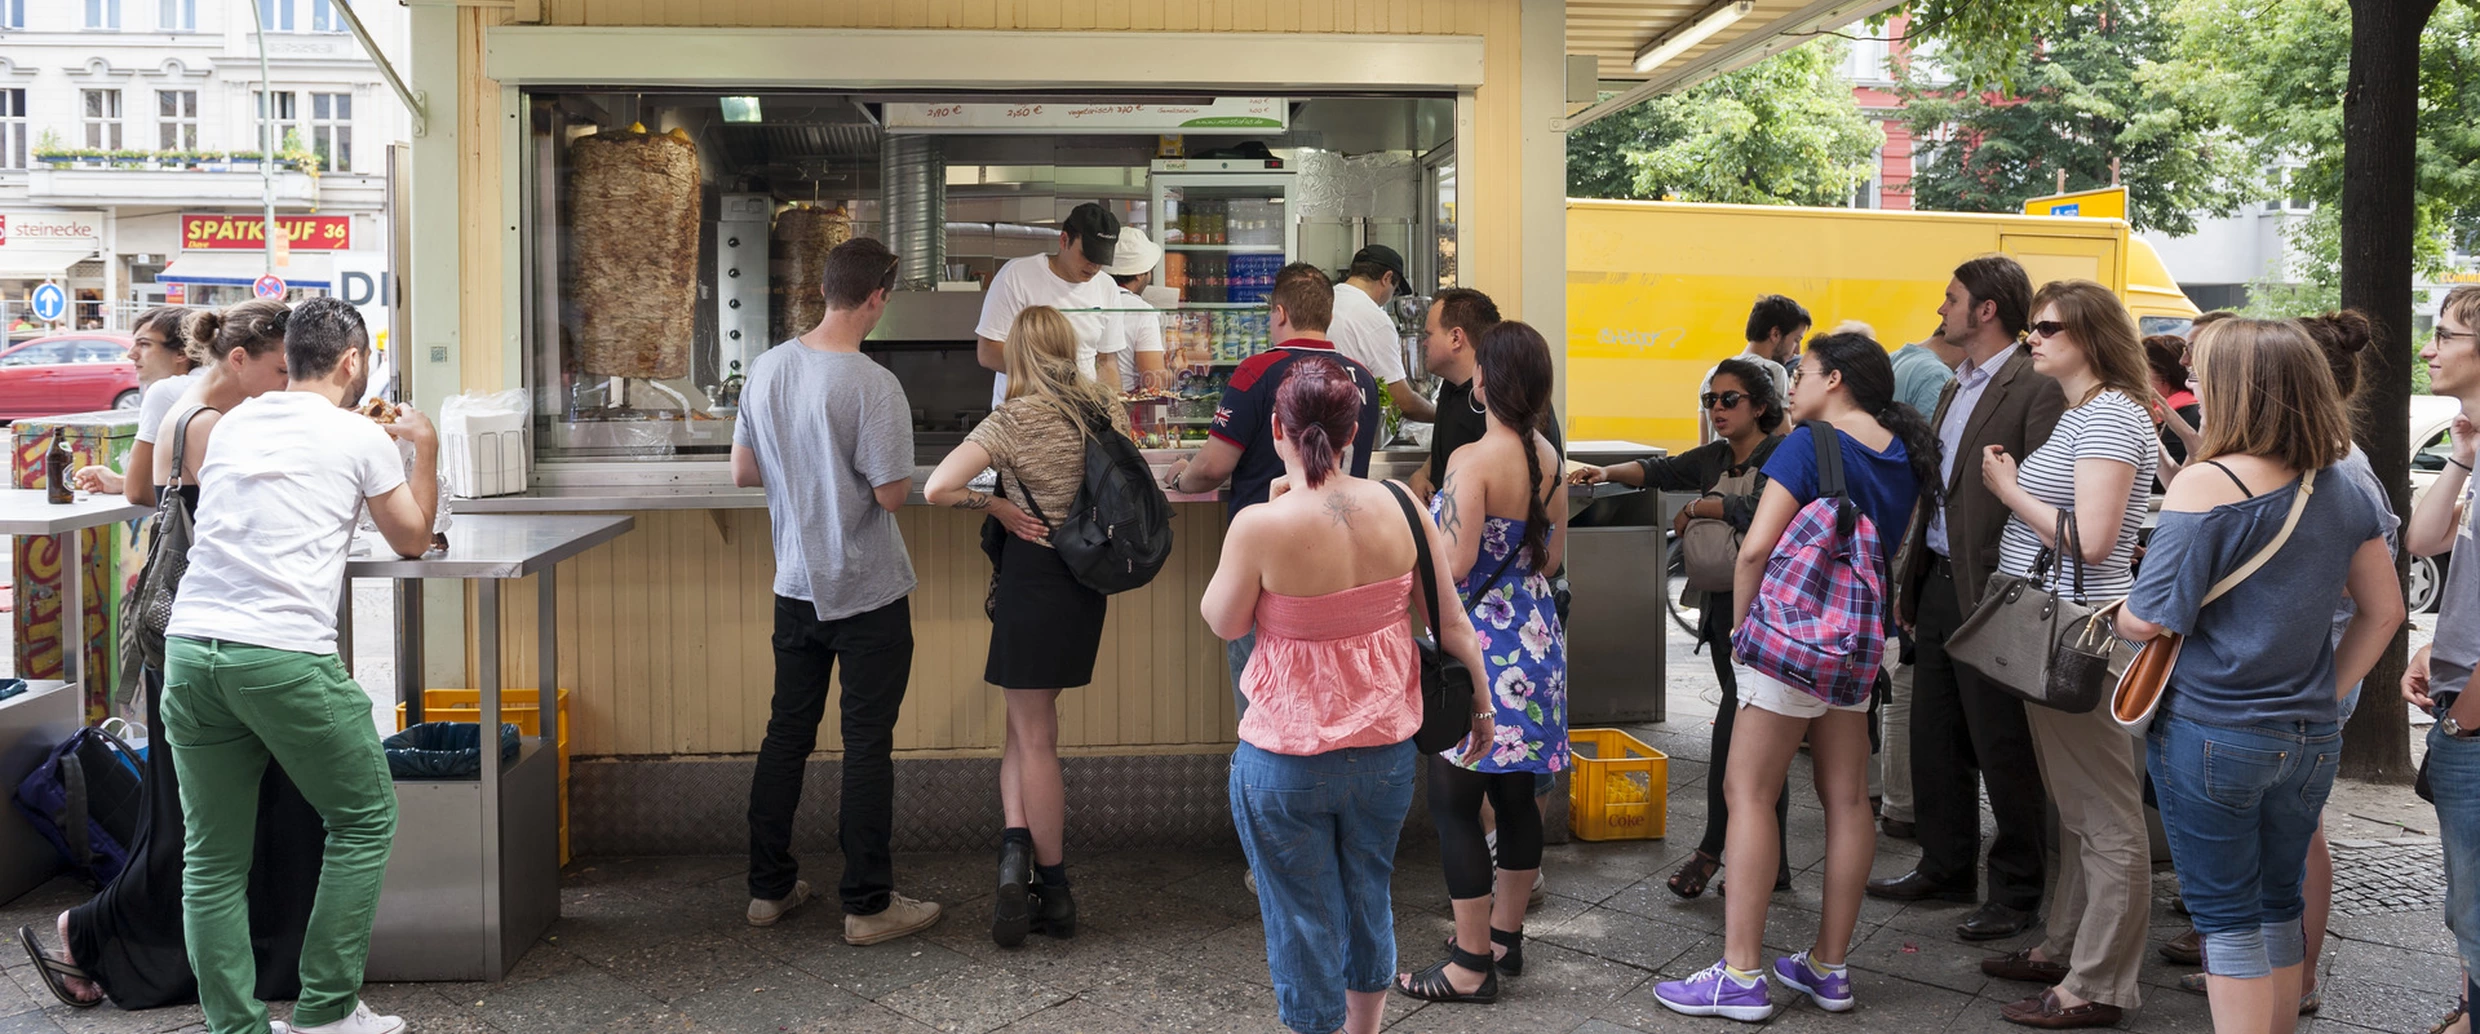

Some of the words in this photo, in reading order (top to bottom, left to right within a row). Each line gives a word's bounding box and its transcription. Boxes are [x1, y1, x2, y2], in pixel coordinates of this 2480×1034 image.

[952, 104, 962, 115] €
[1033, 104, 1043, 115] €
[15, 220, 92, 237] steinecke
[187, 215, 317, 241] SPÄTKUF
[323, 223, 346, 239] 36
[1608, 813, 1646, 829] Coke
